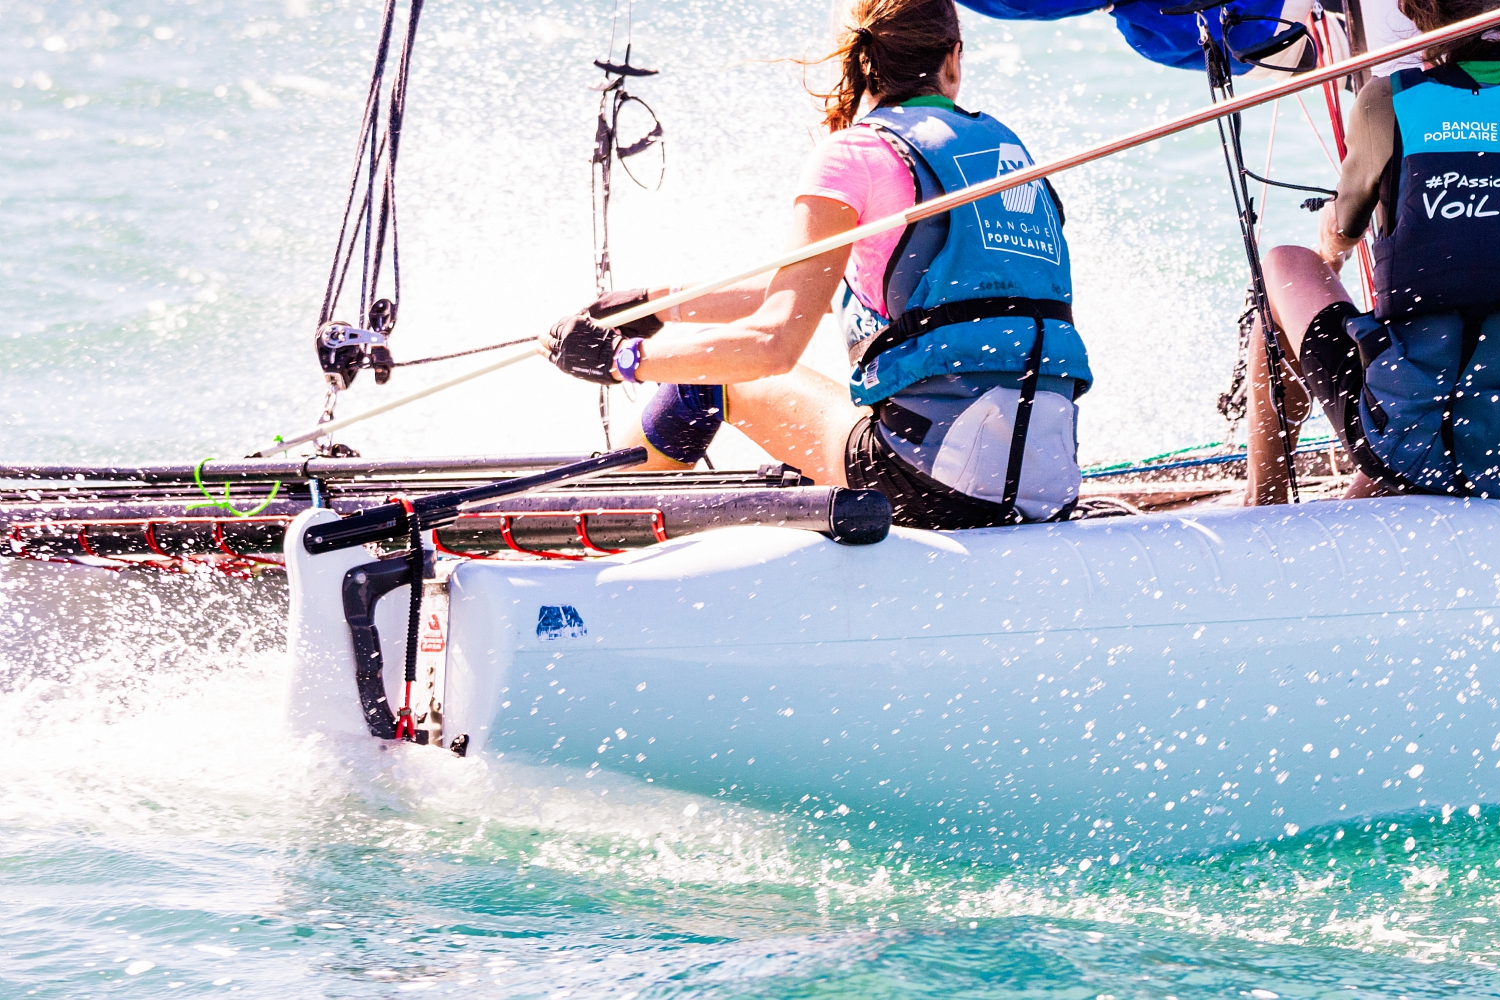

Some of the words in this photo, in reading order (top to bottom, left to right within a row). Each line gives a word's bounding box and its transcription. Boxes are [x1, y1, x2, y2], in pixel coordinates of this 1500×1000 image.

[1442, 121, 1498, 132] BANQUE
[1424, 131, 1498, 142] POPULAIRE
[984, 220, 1050, 238] BANQUE
[987, 233, 1054, 255] POPULAIRE
